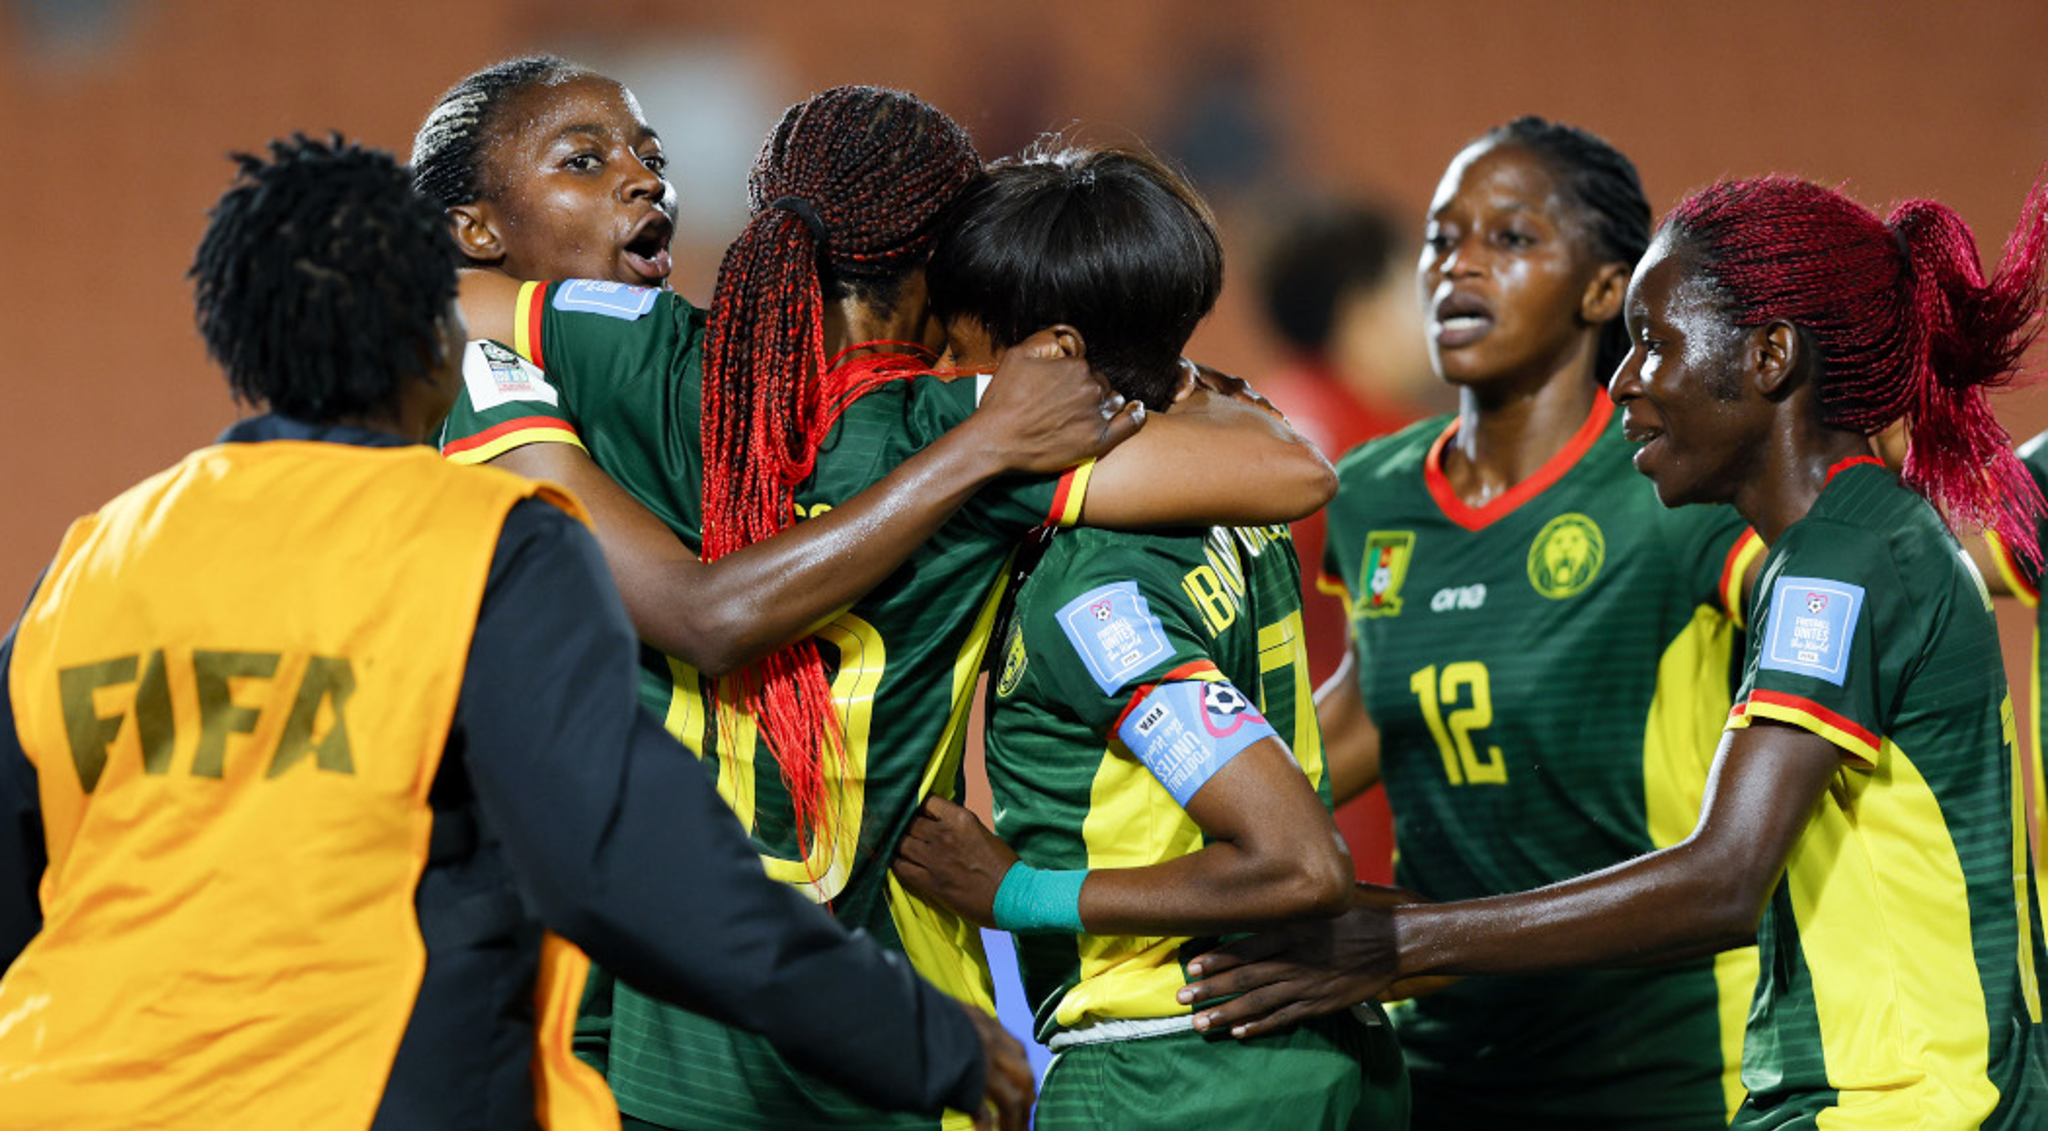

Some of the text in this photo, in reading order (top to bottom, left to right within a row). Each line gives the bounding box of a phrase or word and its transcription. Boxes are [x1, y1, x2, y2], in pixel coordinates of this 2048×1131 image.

[1101, 627, 1136, 651] UNITES
[1794, 626, 1829, 642] UNITES
[58, 648, 357, 795] FIFA
[1139, 707, 1164, 731] FIFA
[1162, 717, 1185, 736] the
[1410, 661, 1508, 785] 12
[1154, 731, 1201, 784] UNITES
[1168, 745, 1210, 794] FOOTBALL
